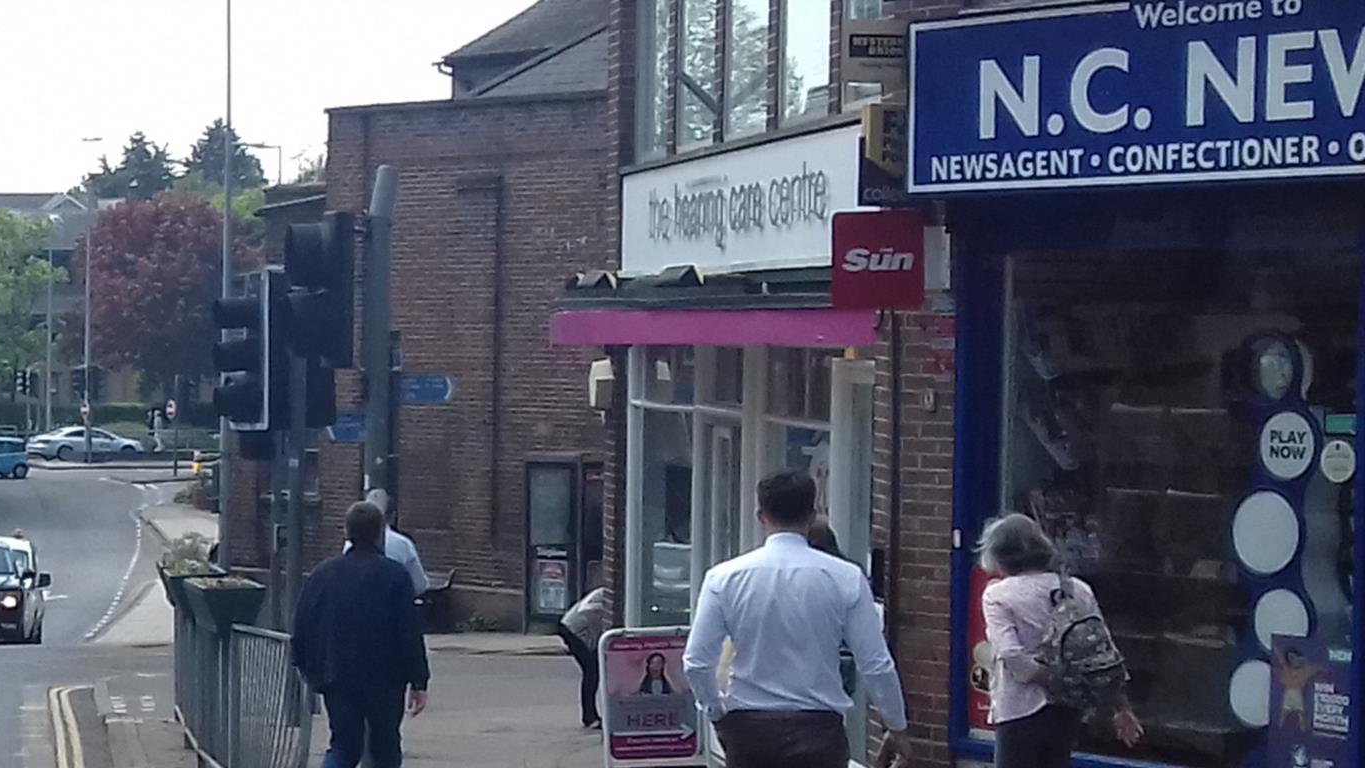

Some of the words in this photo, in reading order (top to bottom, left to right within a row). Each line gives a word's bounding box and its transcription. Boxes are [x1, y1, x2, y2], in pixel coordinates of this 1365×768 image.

[1134, 0, 1263, 29] Welcome
[1271, 0, 1302, 16] to
[978, 47, 1152, 140] N.C.
[930, 148, 1085, 182] NEWSAGENT
[1107, 135, 1320, 173] CONFECTIONER
[648, 188, 670, 240] the
[729, 180, 764, 231] care
[769, 161, 827, 227] centre
[841, 248, 915, 272] Sun
[1269, 430, 1307, 445] PLAY
[1269, 446, 1307, 460] NOW
